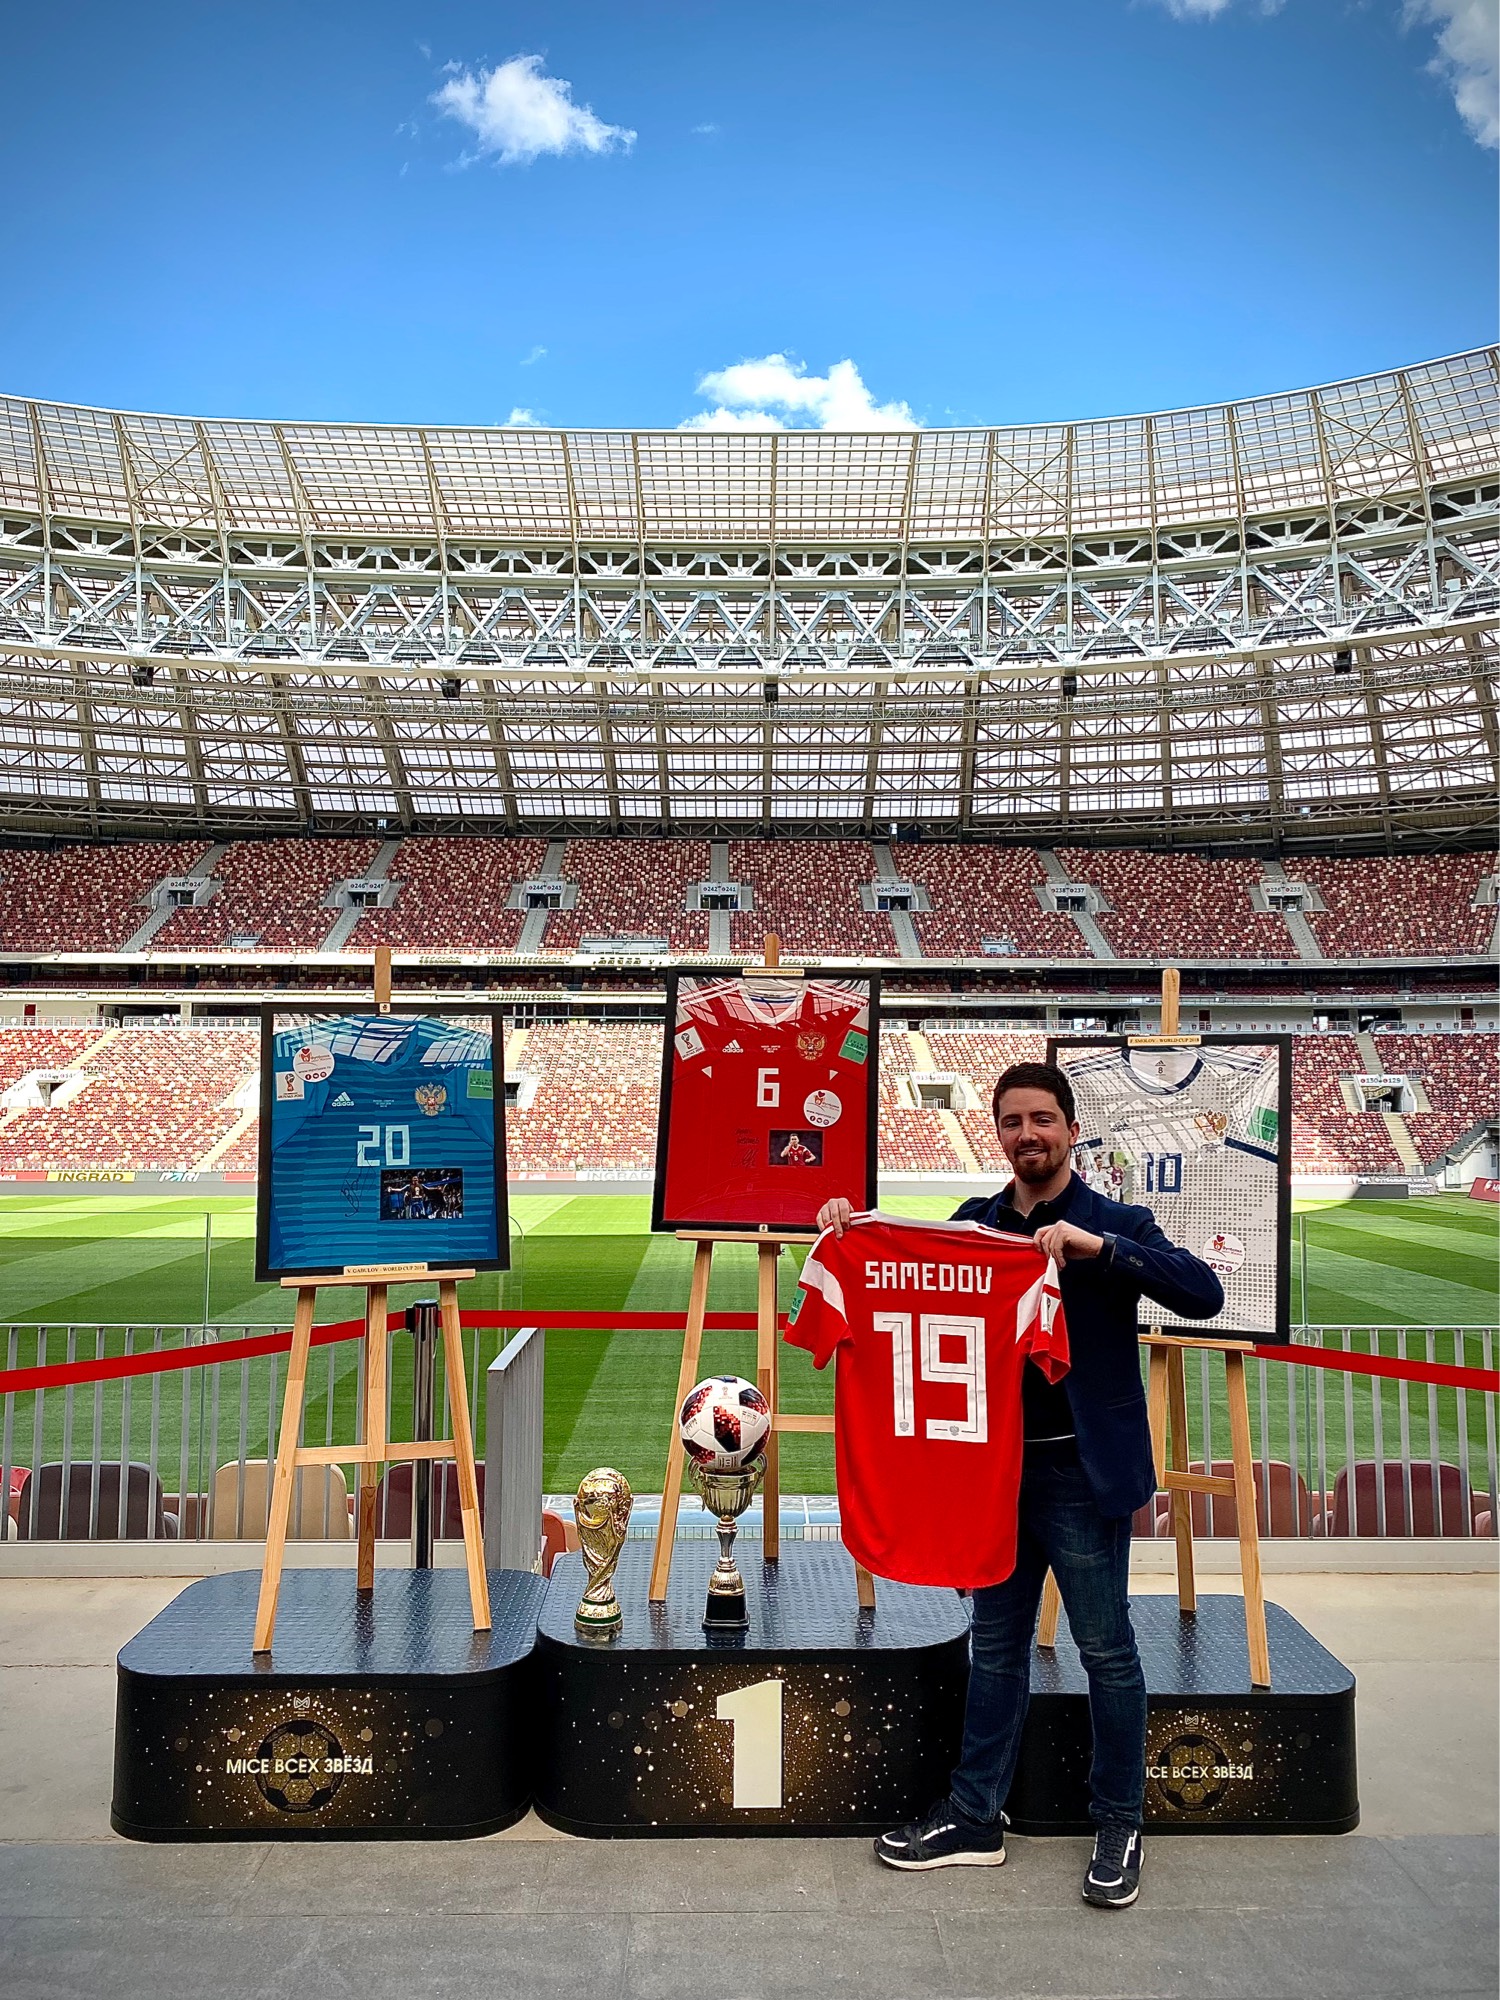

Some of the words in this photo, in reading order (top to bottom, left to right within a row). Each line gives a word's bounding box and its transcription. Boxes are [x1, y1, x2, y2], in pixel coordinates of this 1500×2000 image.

[757, 1067, 780, 1107] 6
[357, 1124, 410, 1167] 20
[57, 1172, 124, 1182] INGRAD
[587, 1171, 651, 1180] INGRAD
[1141, 1152, 1182, 1193] 10
[865, 1260, 992, 1294] SAMEDOV
[873, 1311, 988, 1443] 19
[716, 1679, 784, 1808] 1
[226, 1758, 270, 1774] MICE
[274, 1758, 319, 1773] ВСЕХ
[323, 1755, 374, 1775] ЗВЁЗД
[1144, 1766, 1168, 1779] ICE
[1172, 1766, 1209, 1779] ВСЕХ
[1212, 1763, 1254, 1780] ЗВЁЗД
